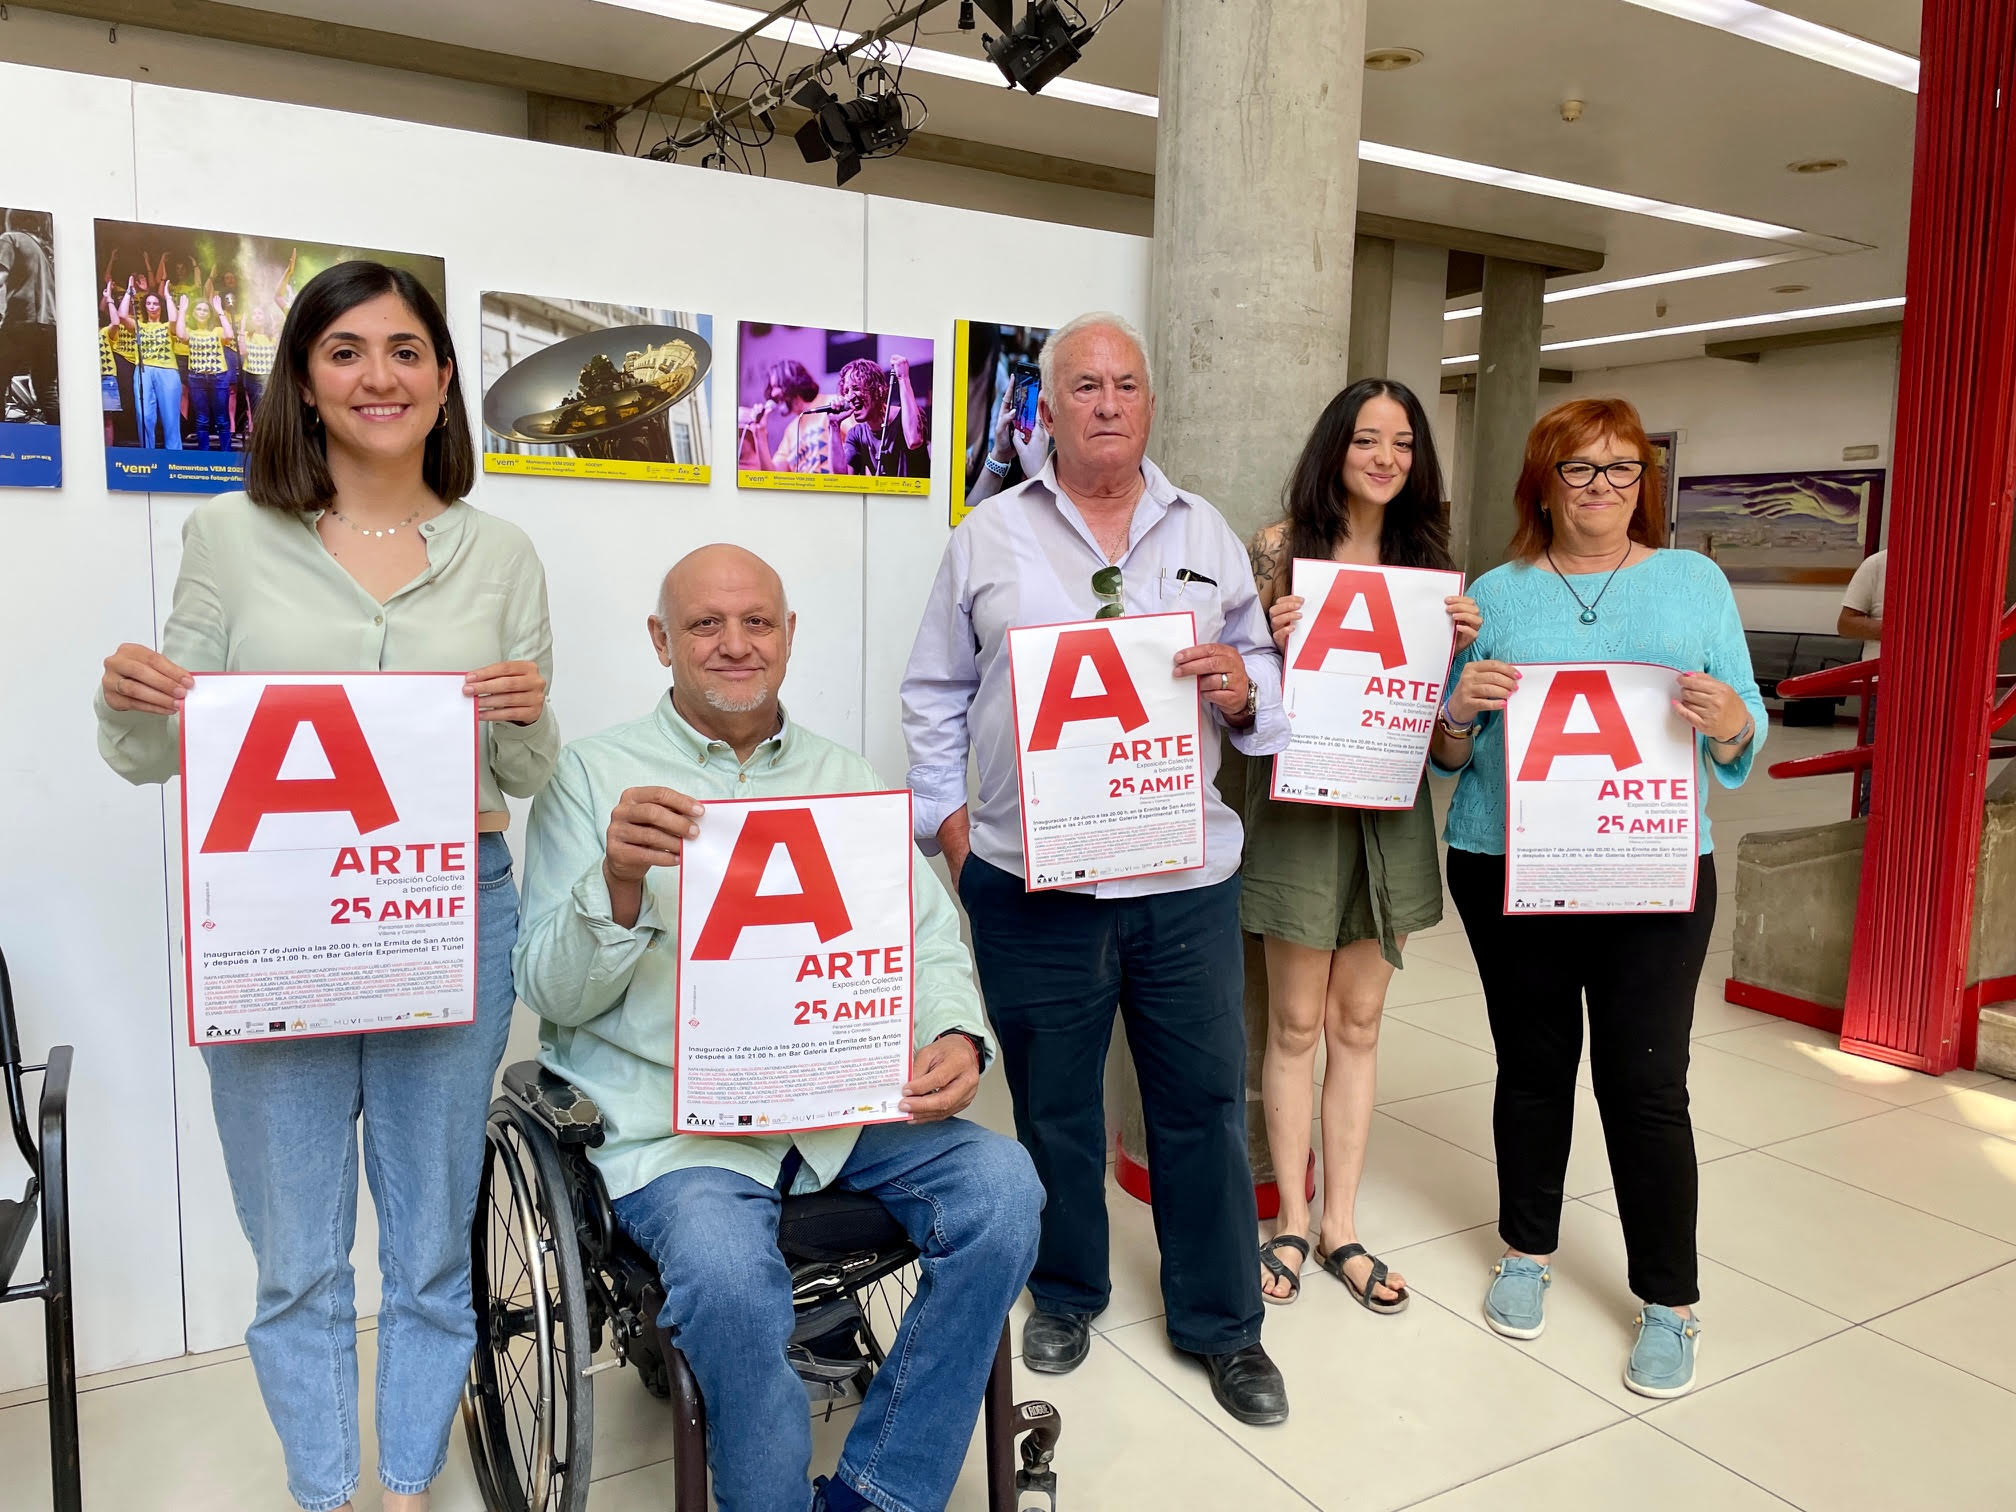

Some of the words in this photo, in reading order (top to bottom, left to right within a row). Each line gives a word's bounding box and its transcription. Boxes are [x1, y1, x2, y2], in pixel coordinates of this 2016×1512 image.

[168, 464, 208, 472] Momentos
[1292, 569, 1408, 672] A
[1027, 628, 1150, 752] A
[1364, 676, 1440, 702] ARTE
[1361, 709, 1385, 727] 25
[1388, 716, 1431, 733] AMIF
[1516, 670, 1643, 782] A
[1108, 734, 1194, 764] ARTE
[199, 684, 400, 854] A
[1108, 777, 1135, 798] 25
[1140, 774, 1194, 794] AMIF
[1598, 779, 1688, 800] ARTE
[1597, 815, 1624, 833] 25
[1629, 819, 1688, 833] AMIF
[330, 842, 465, 878] ARTE
[376, 875, 423, 886] Exposición
[426, 873, 465, 883] Colectiva
[411, 884, 449, 893] beneficio
[690, 808, 853, 961] A
[330, 897, 372, 924] 25
[379, 897, 465, 922] AMIF
[204, 950, 260, 958] Inauguración
[328, 942, 350, 950] 20.00
[212, 957, 249, 967] después
[376, 946, 428, 956] Experimental
[795, 946, 903, 982] ARTE
[832, 979, 870, 990] Exposición
[872, 976, 903, 985] Colectiva
[860, 985, 891, 994] beneficio
[793, 1000, 828, 1025] 25
[833, 996, 903, 1022] AMIF
[206, 1028, 241, 1037] KAKV
[830, 1044, 872, 1053] Experimental
[1028, 1405, 1049, 1417] ROGUE
